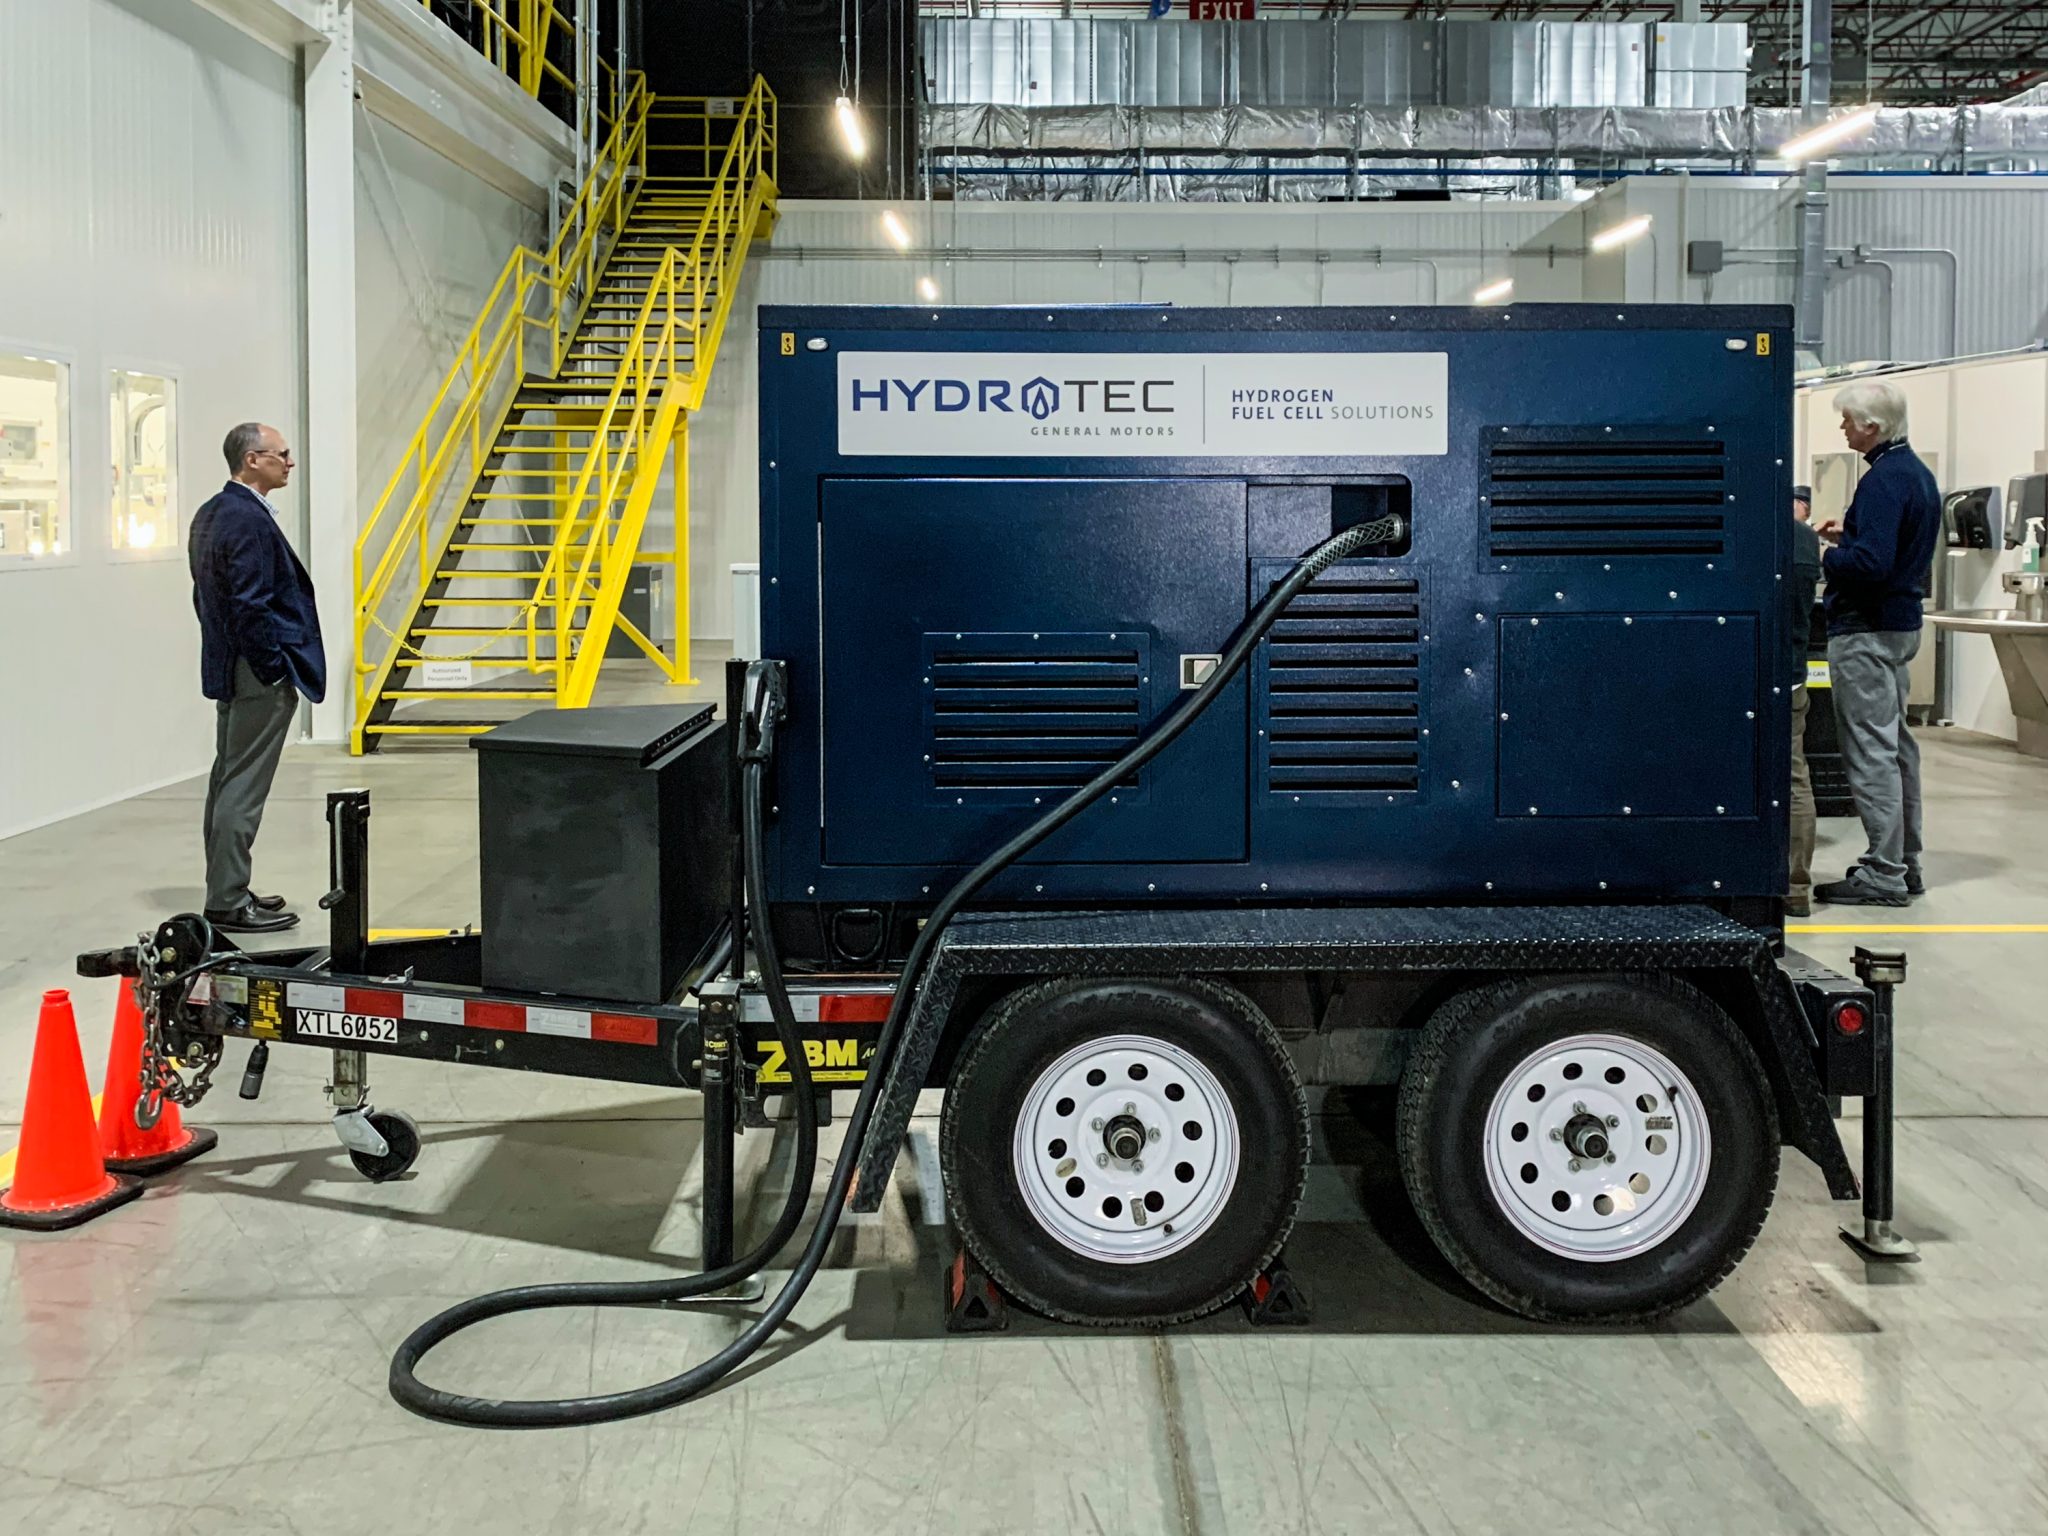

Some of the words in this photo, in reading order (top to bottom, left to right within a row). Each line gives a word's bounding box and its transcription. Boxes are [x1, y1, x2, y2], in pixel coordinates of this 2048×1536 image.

[1199, 2, 1243, 20] EXIT
[1232, 389, 1334, 403] HYDROGEN
[1232, 406, 1275, 420] FUEL
[1283, 406, 1324, 420] CELL
[1331, 405, 1434, 419] SOLUTIONS
[1030, 426, 1101, 436] GENERAL
[1110, 426, 1175, 436] MOTORS
[298, 1010, 396, 1041] XTL6052
